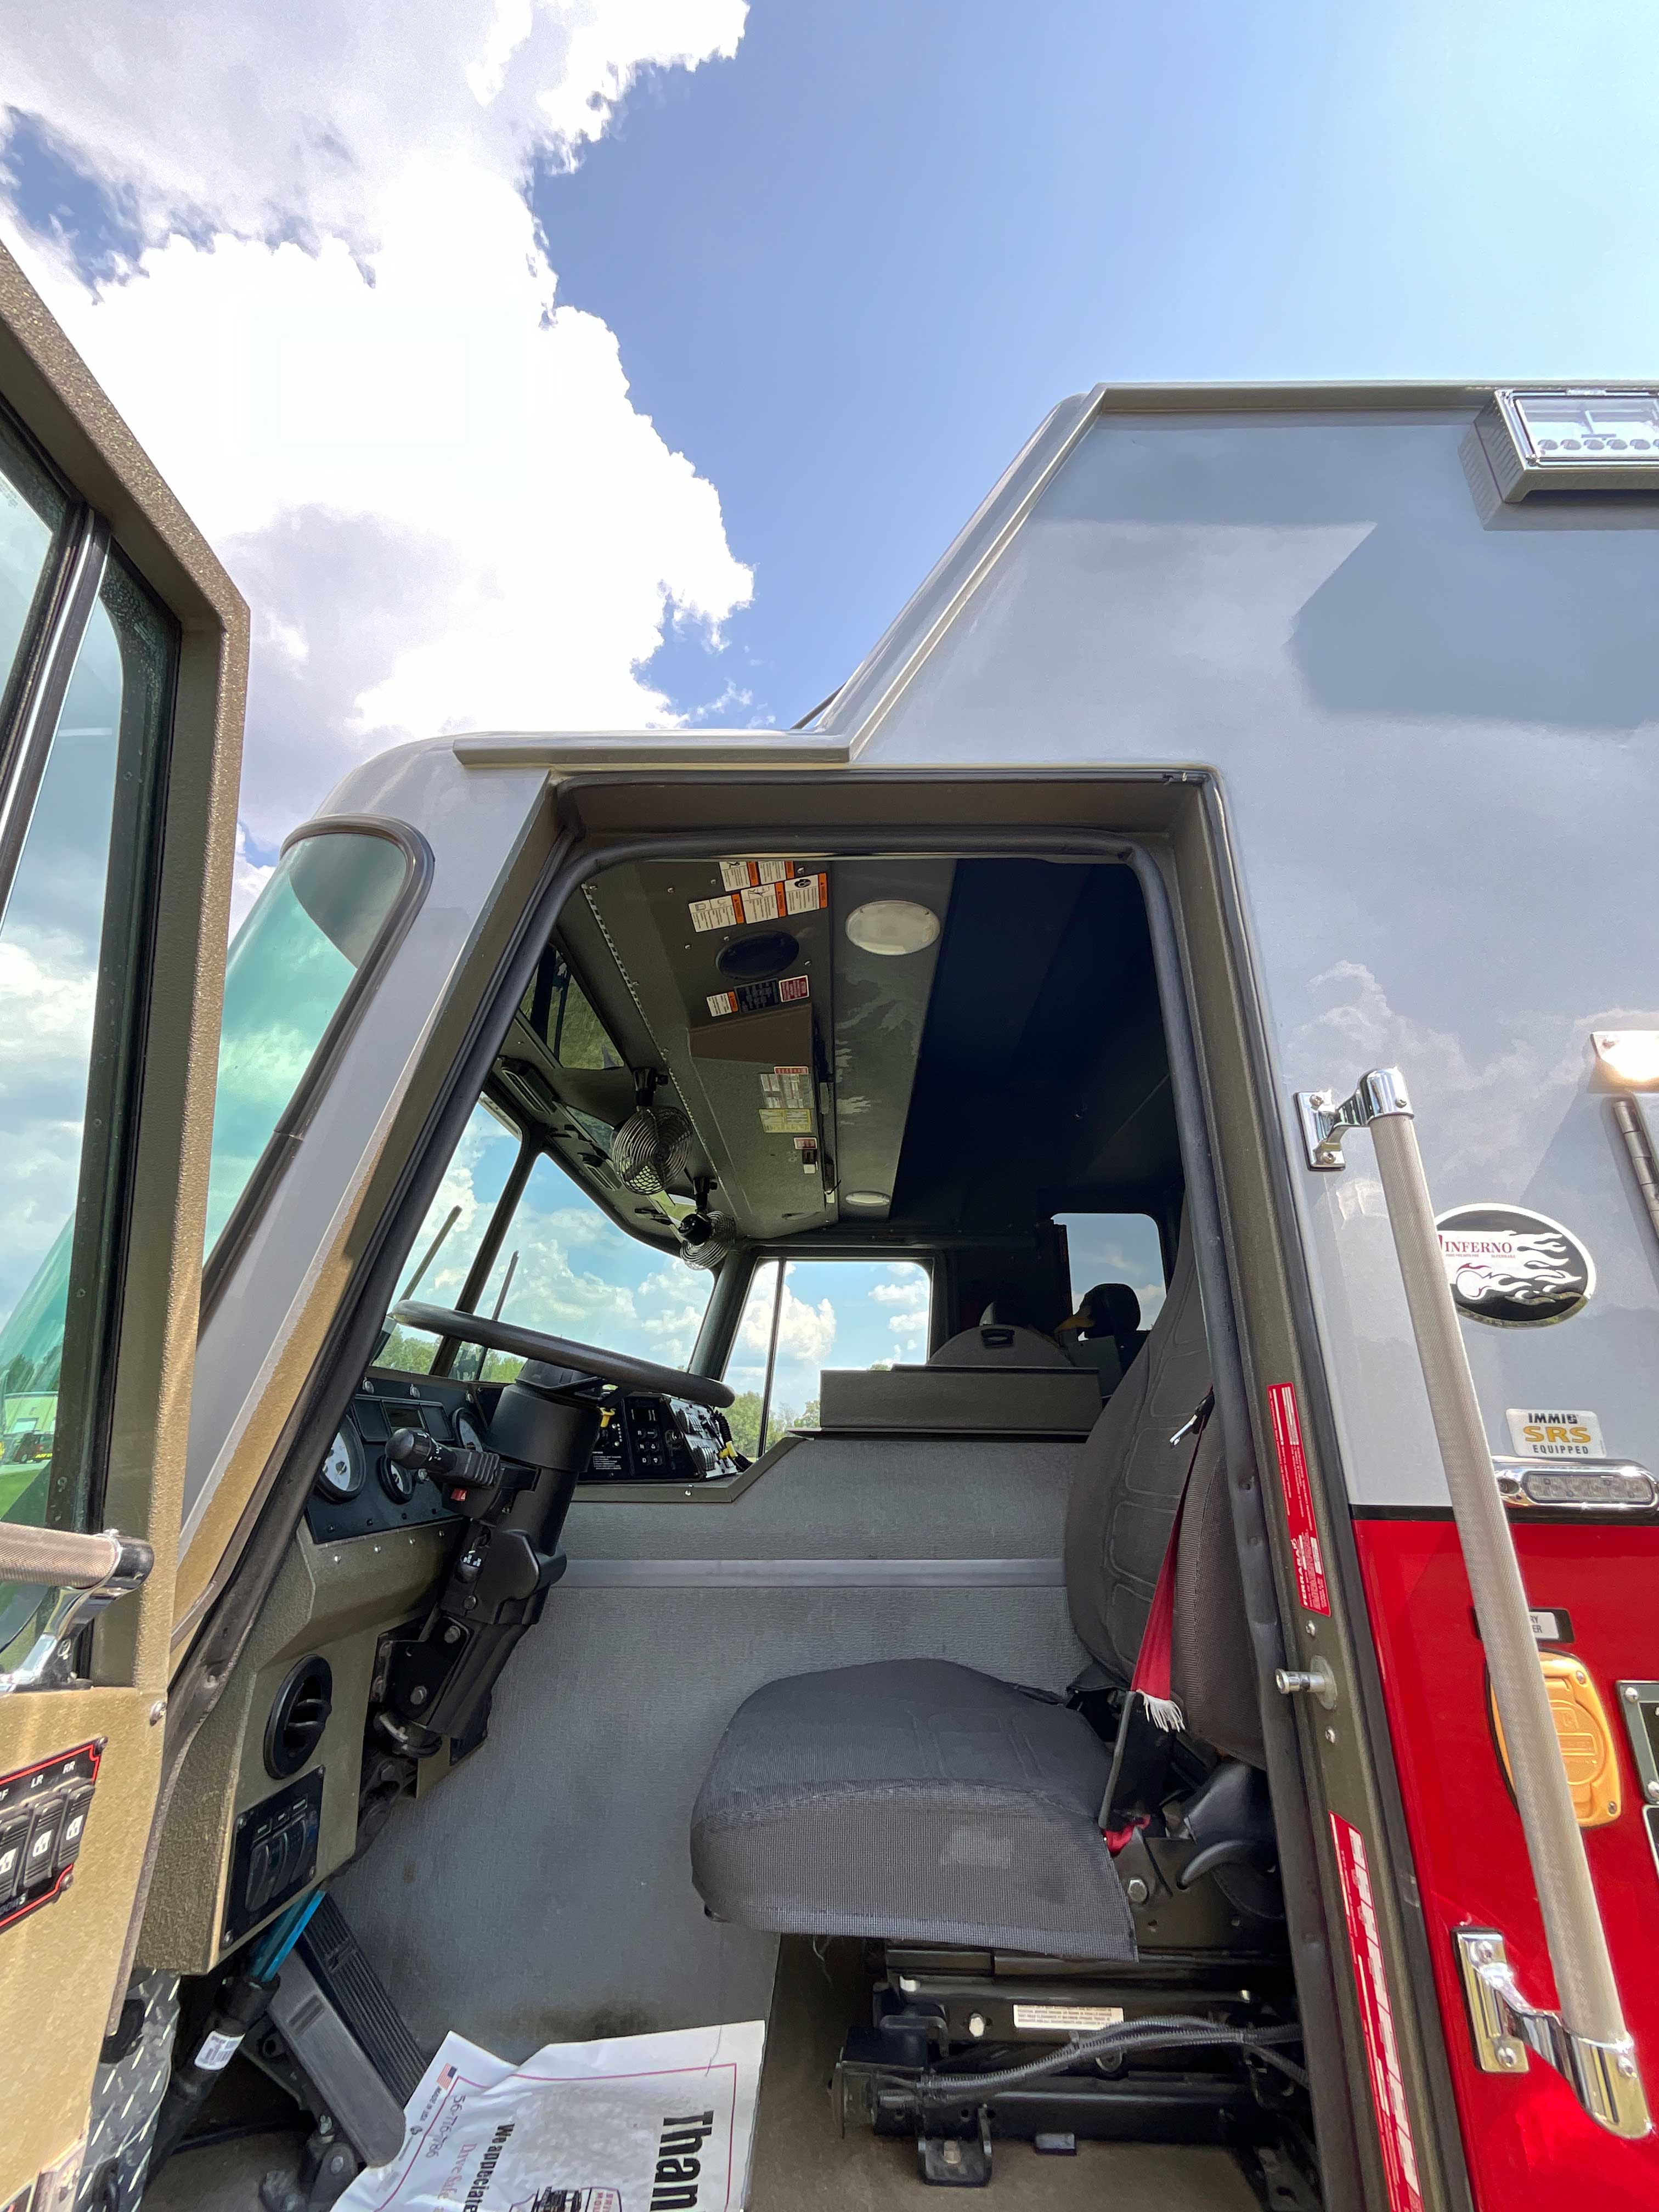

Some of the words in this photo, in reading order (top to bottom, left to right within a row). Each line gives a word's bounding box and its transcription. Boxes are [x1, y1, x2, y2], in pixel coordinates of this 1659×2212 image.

[1444, 1241, 1512, 1253] INFERNO
[1523, 1426, 1591, 1443] SRS
[1533, 1444, 1589, 1454] EQUIPPED
[62, 1760, 76, 1774] RR
[31, 1774, 44, 1788] LR
[492, 2123, 516, 2144] We
[650, 2111, 714, 2212] Than
